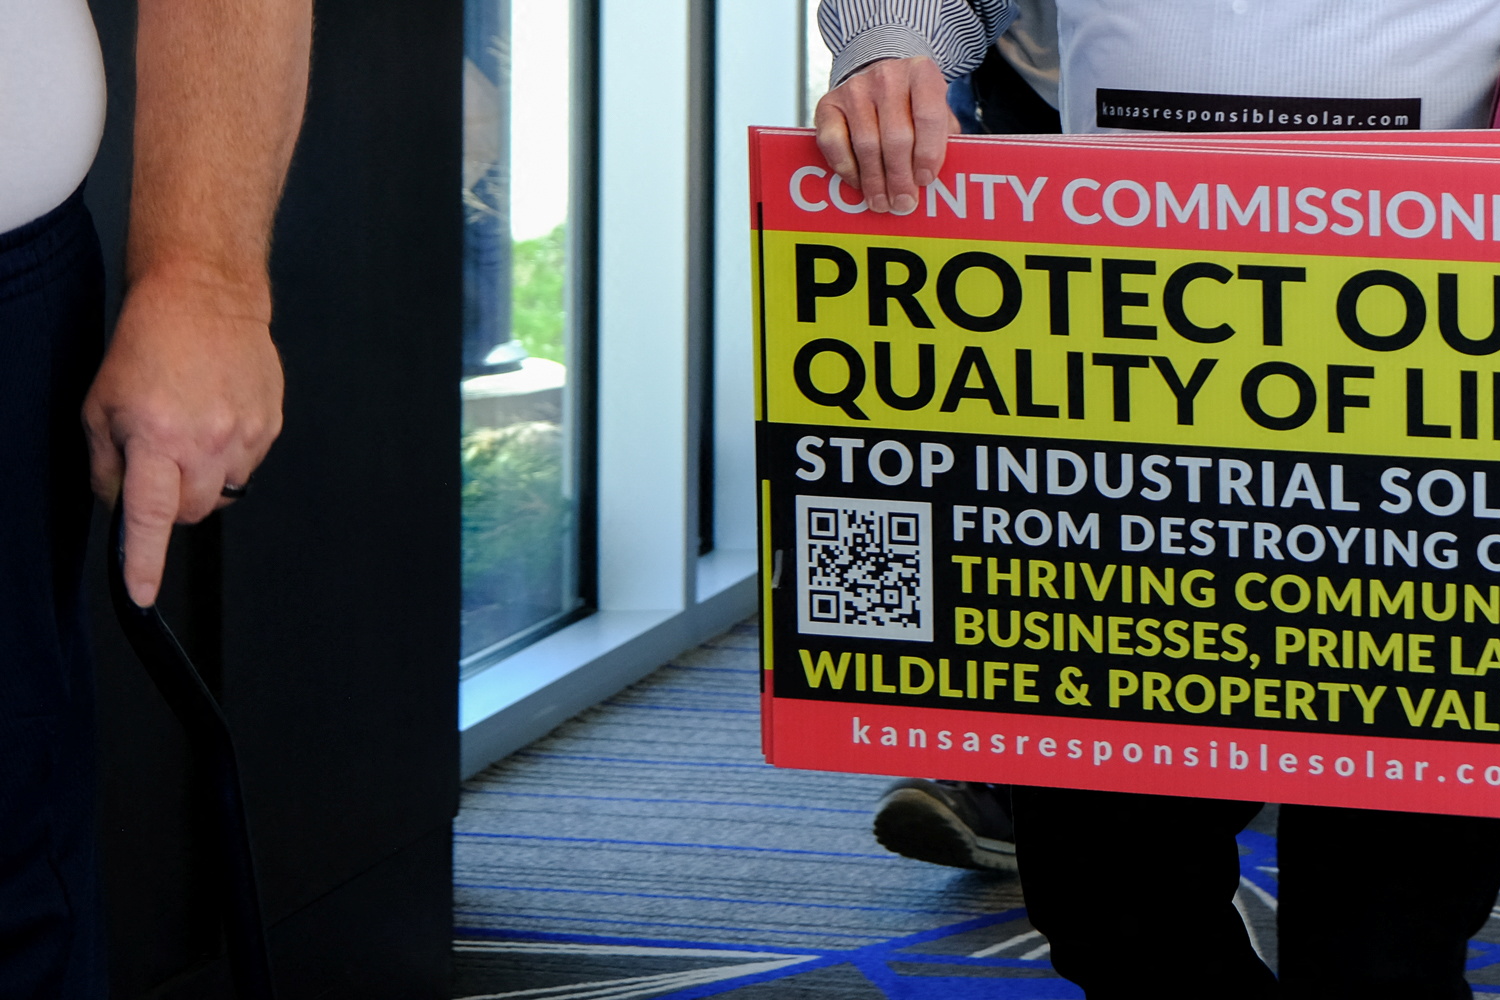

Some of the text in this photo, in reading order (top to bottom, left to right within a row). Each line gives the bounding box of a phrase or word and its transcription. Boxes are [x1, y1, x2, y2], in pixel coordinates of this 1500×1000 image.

[1102, 101, 1409, 126] kansasresponsiblesolar.com
[790, 166, 1048, 221] CONTY
[795, 244, 1306, 346] PROTECT
[794, 338, 1218, 425] QUALITY
[1241, 361, 1374, 433] OF
[796, 436, 954, 487] STOP
[976, 446, 1360, 511] INDUSTRIAL
[954, 505, 1099, 549] FROM
[1121, 515, 1458, 569] DESTROYING
[952, 555, 1215, 608] THRIVING
[955, 607, 1260, 669] BUSINESSES,
[1276, 627, 1435, 673] PRIME
[799, 649, 1039, 702] WILDLIFE
[1056, 667, 1091, 706] &
[1109, 669, 1387, 724] PROPERTY
